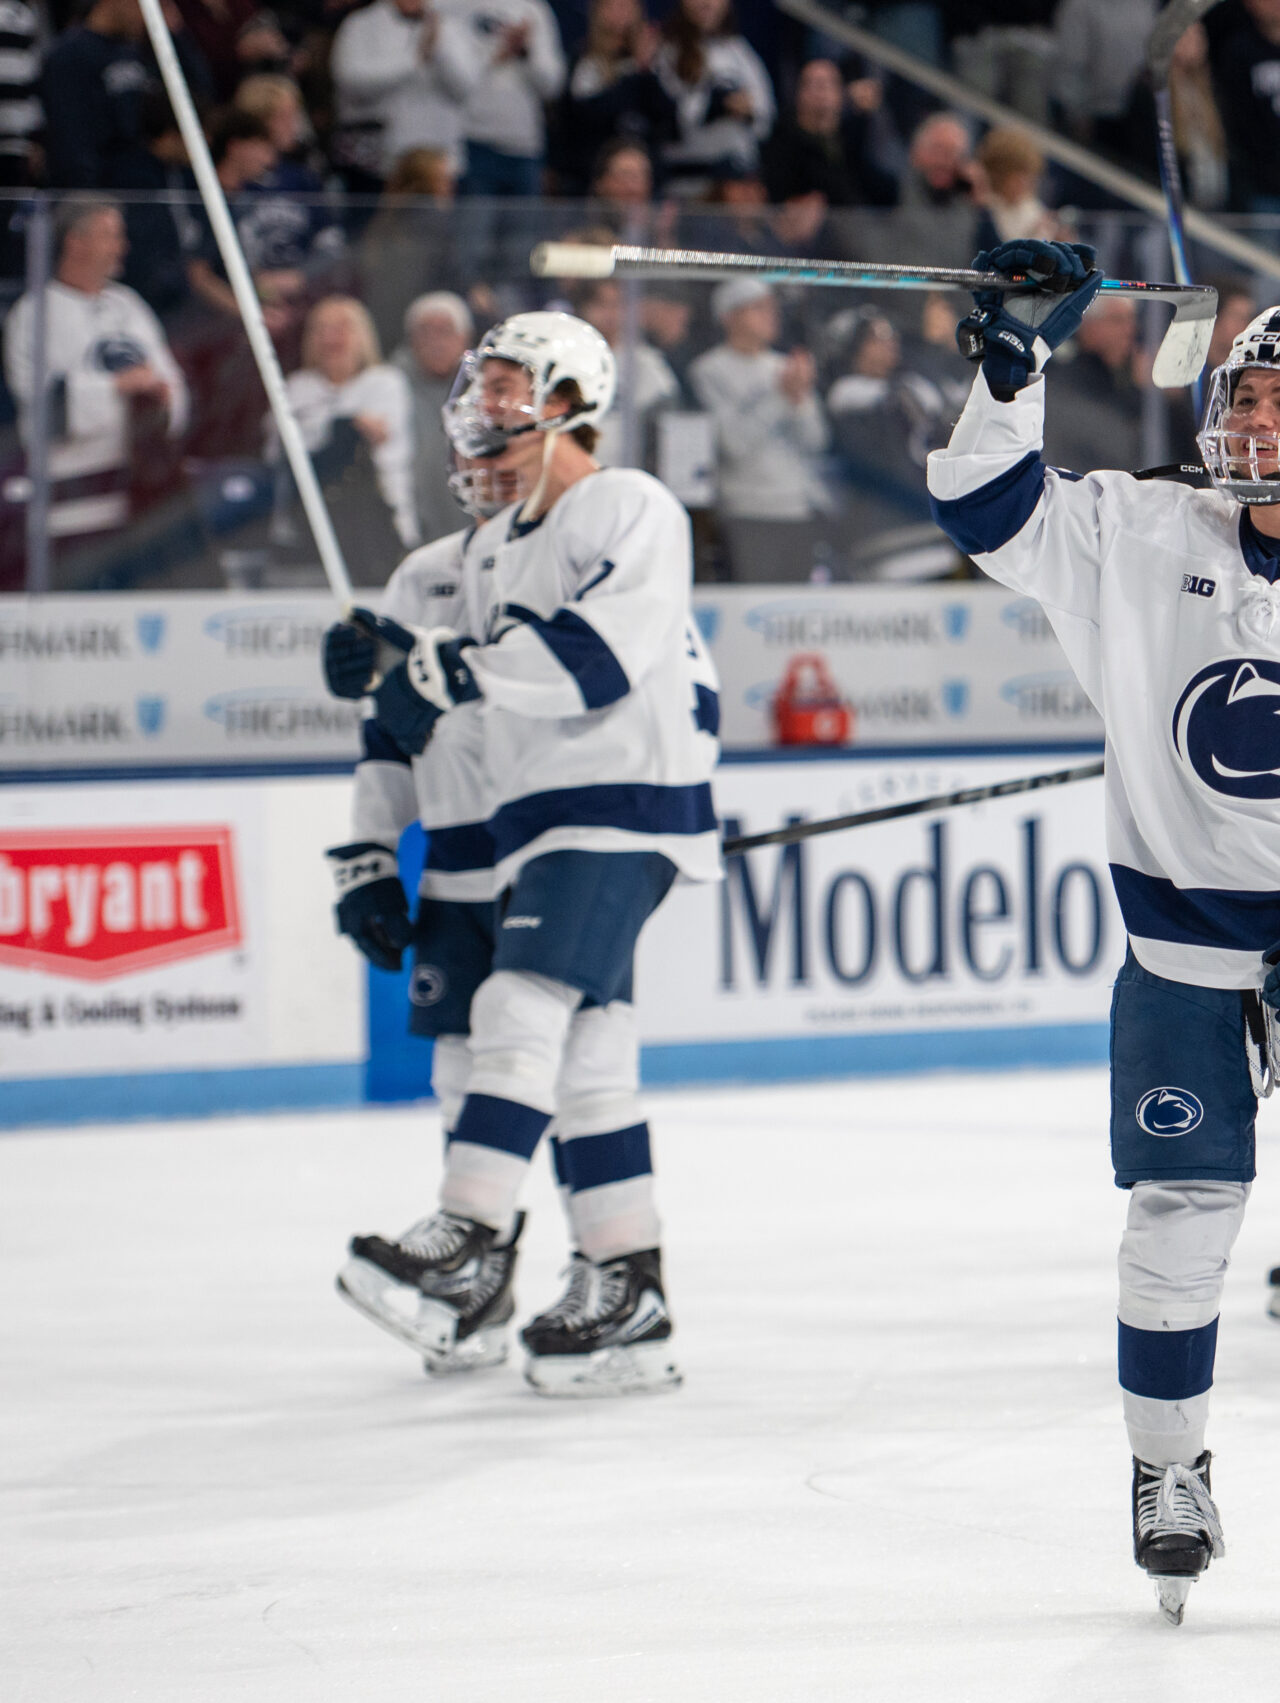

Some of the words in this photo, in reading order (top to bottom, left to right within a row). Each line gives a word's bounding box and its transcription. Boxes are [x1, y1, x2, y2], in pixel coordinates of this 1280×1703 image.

[1180, 463, 1204, 475] CCM
[0, 847, 209, 947] bryant
[719, 812, 1105, 992] Modelo
